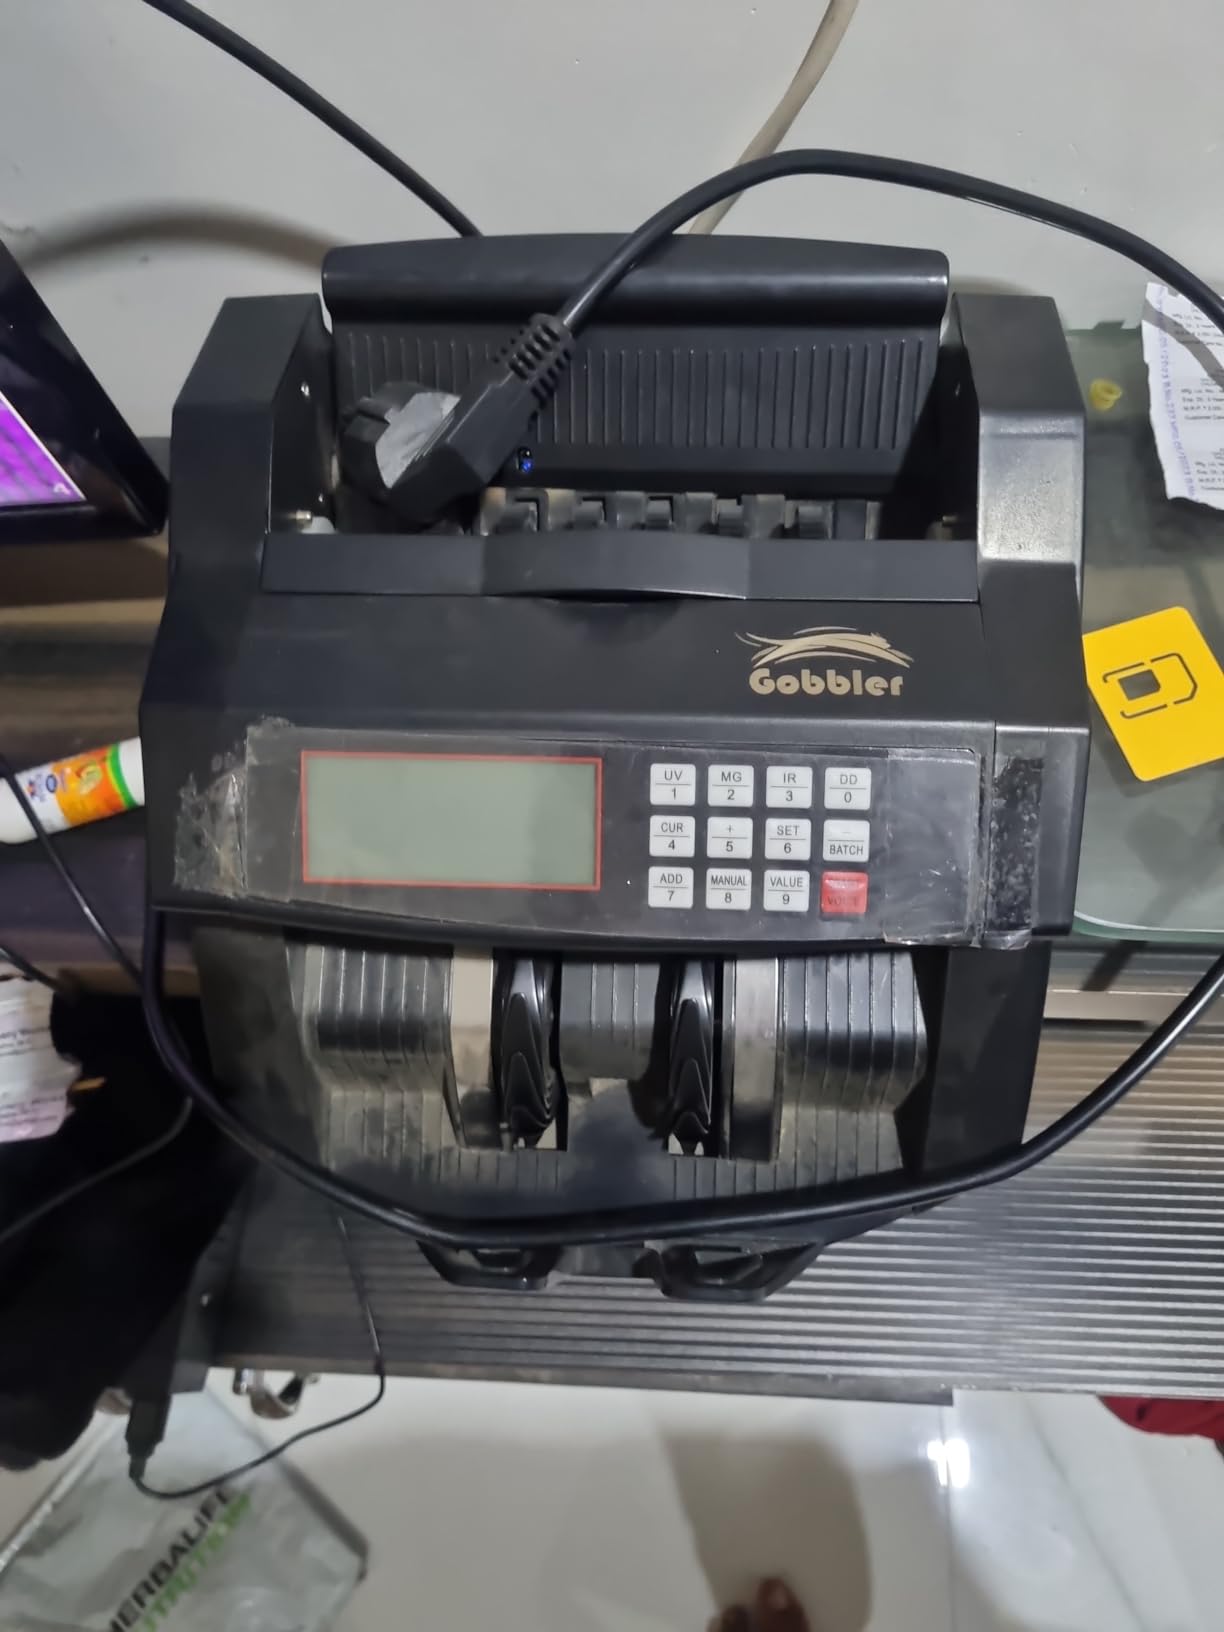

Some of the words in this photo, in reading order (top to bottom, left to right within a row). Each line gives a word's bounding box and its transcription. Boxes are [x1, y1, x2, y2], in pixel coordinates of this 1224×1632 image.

[749, 668, 903, 696] Gobbler
[664, 770, 683, 781] UV
[721, 772, 742, 782] MG
[783, 773, 797, 783] IR
[840, 775, 858, 785] DD
[671, 788, 677, 800] 1
[727, 789, 735, 801] 2
[786, 790, 793, 802] 3
[661, 822, 684, 833] CUR
[777, 825, 800, 836] SET
[668, 839, 676, 851] 4
[726, 841, 733, 853] 5
[784, 842, 791, 854] 6
[829, 844, 863, 855] BATCH
[660, 873, 683, 884] ADD
[711, 875, 747, 886] MANUAL
[771, 877, 803, 887] VALUE
[667, 891, 674, 901] 7
[724, 892, 732, 903] 8
[782, 894, 790, 905] 9
